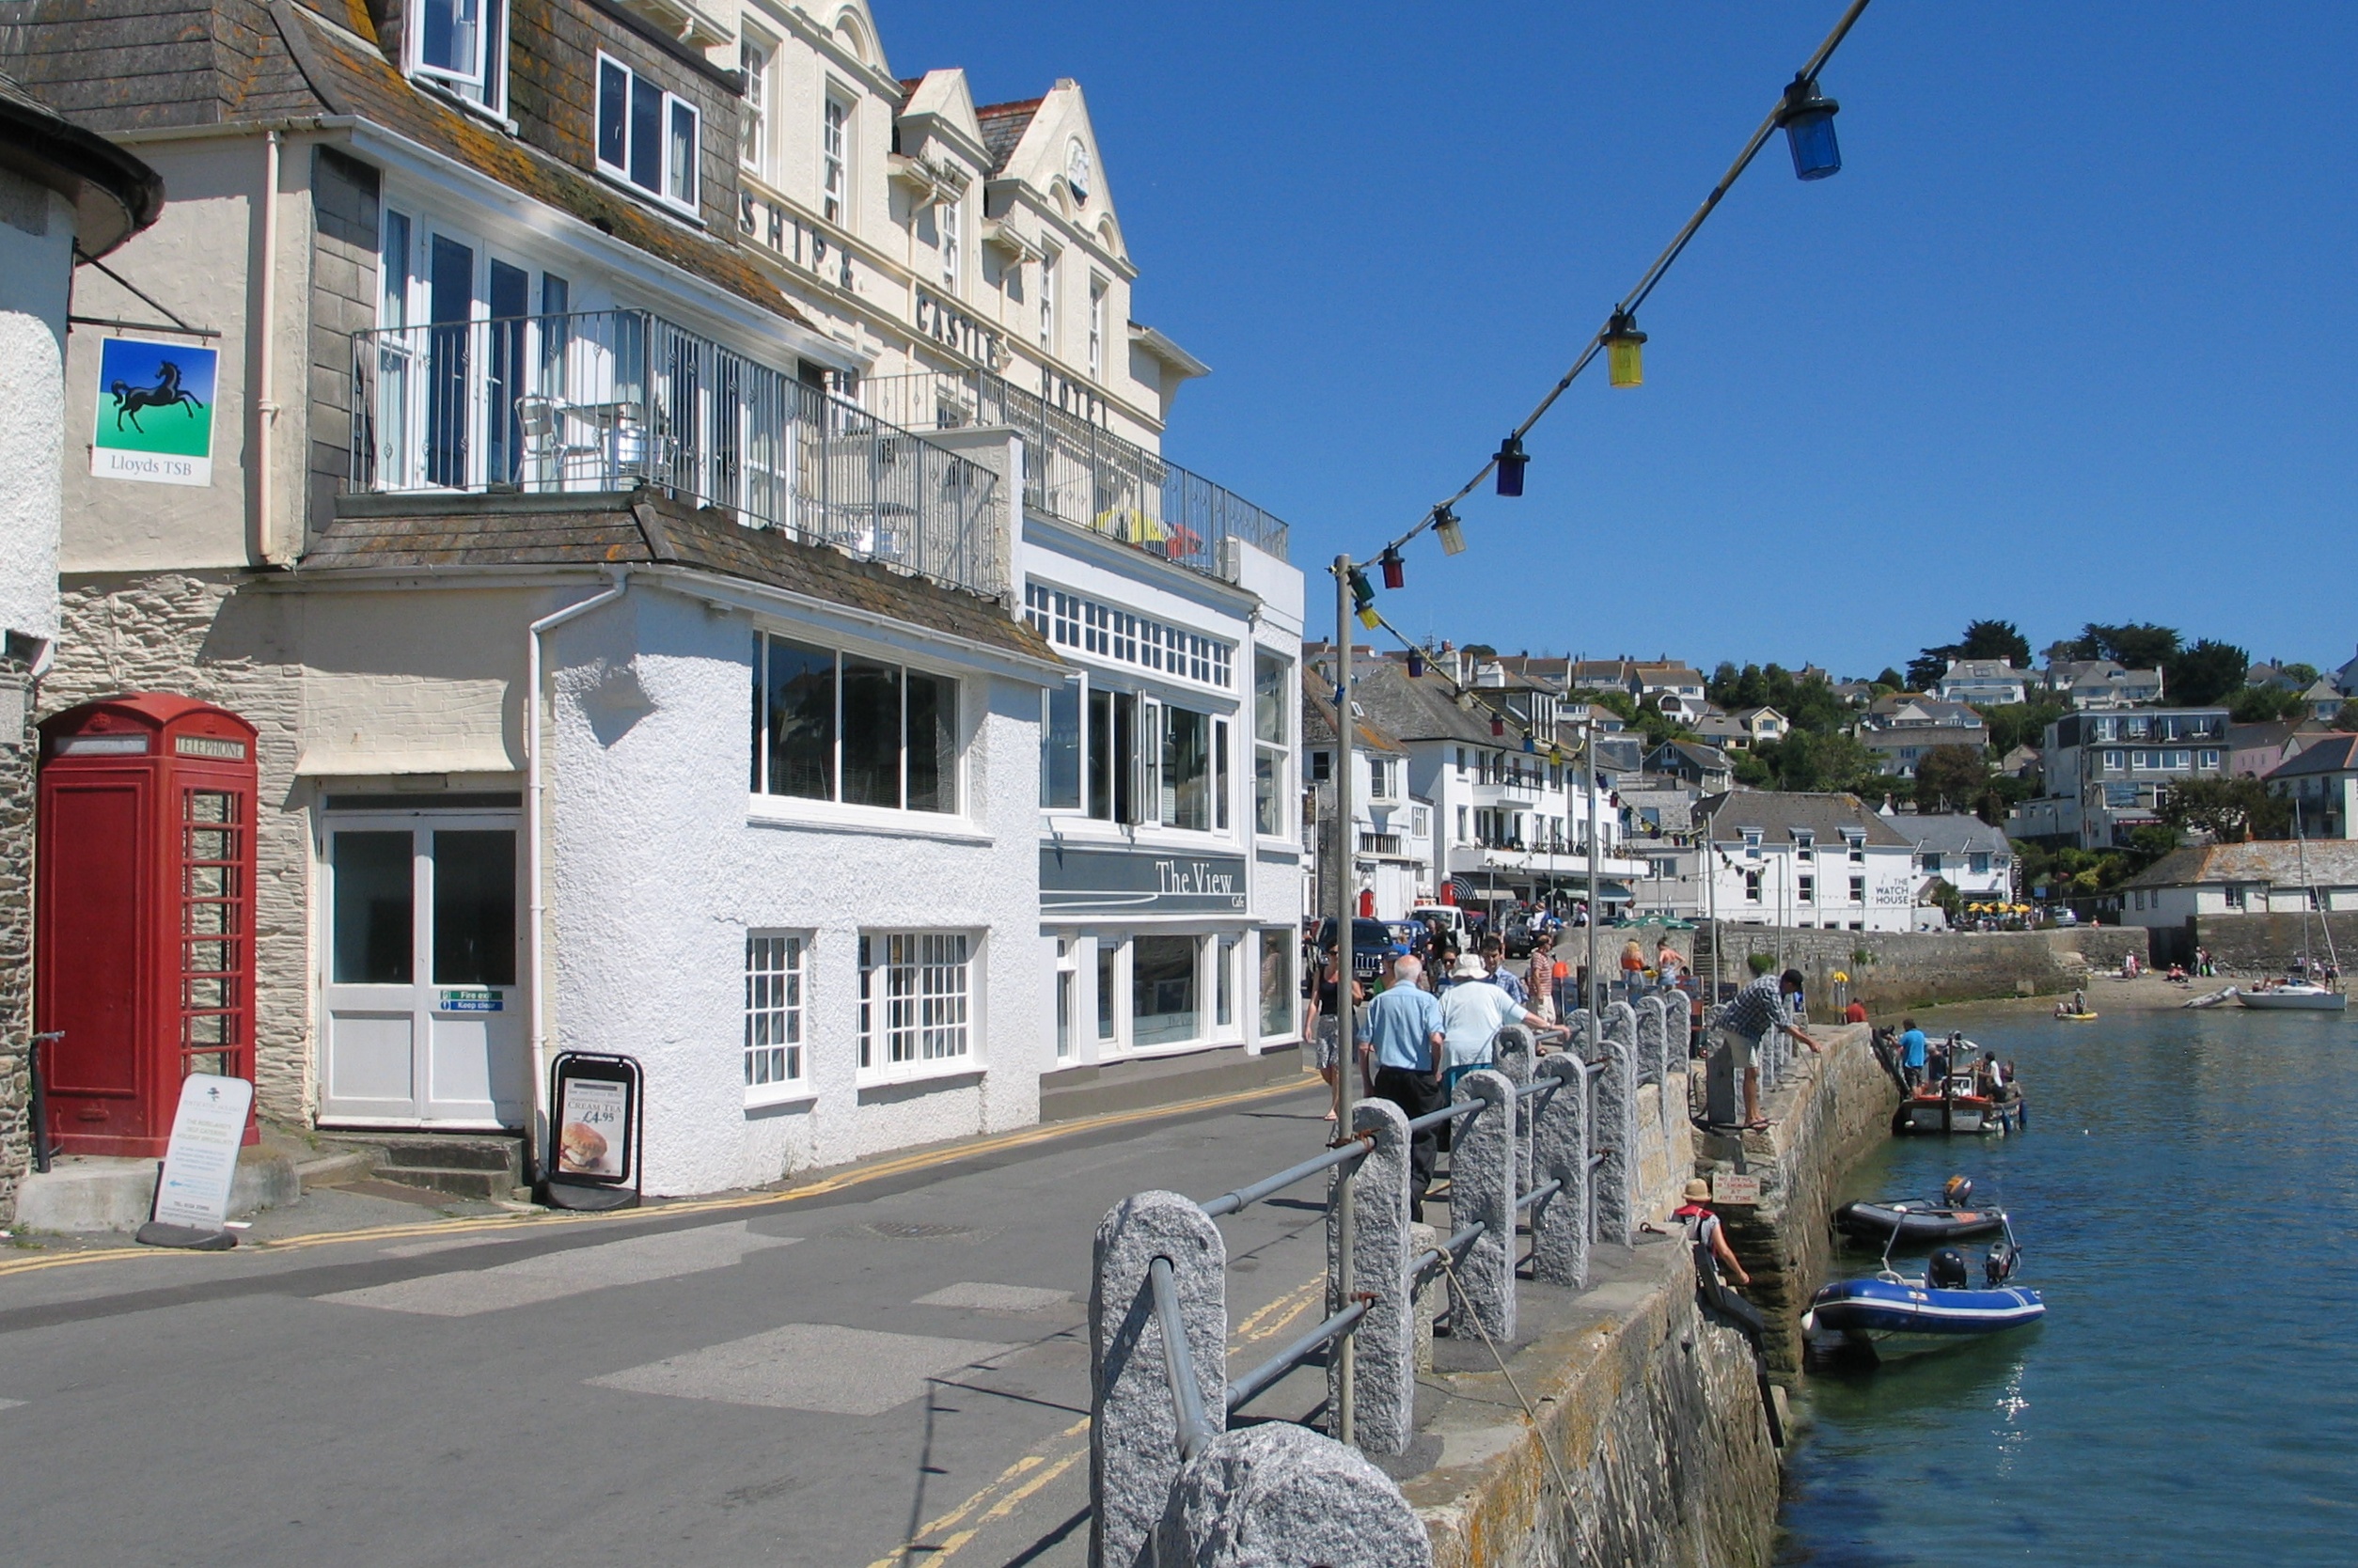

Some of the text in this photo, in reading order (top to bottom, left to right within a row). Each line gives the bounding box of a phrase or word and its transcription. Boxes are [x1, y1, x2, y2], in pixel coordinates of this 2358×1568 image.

[739, 190, 1113, 431] SHIP & CASTLE HOTEL
[111, 454, 192, 476] Lloyds TSB
[178, 737, 242, 758] TELEPHONE
[1155, 859, 1234, 893] The View
[1894, 877, 1909, 886] THE
[1875, 886, 1909, 894] WATCH
[1875, 896, 1909, 904] HOUSE
[567, 1101, 601, 1111] CREAM
[605, 1103, 622, 1113] TEA
